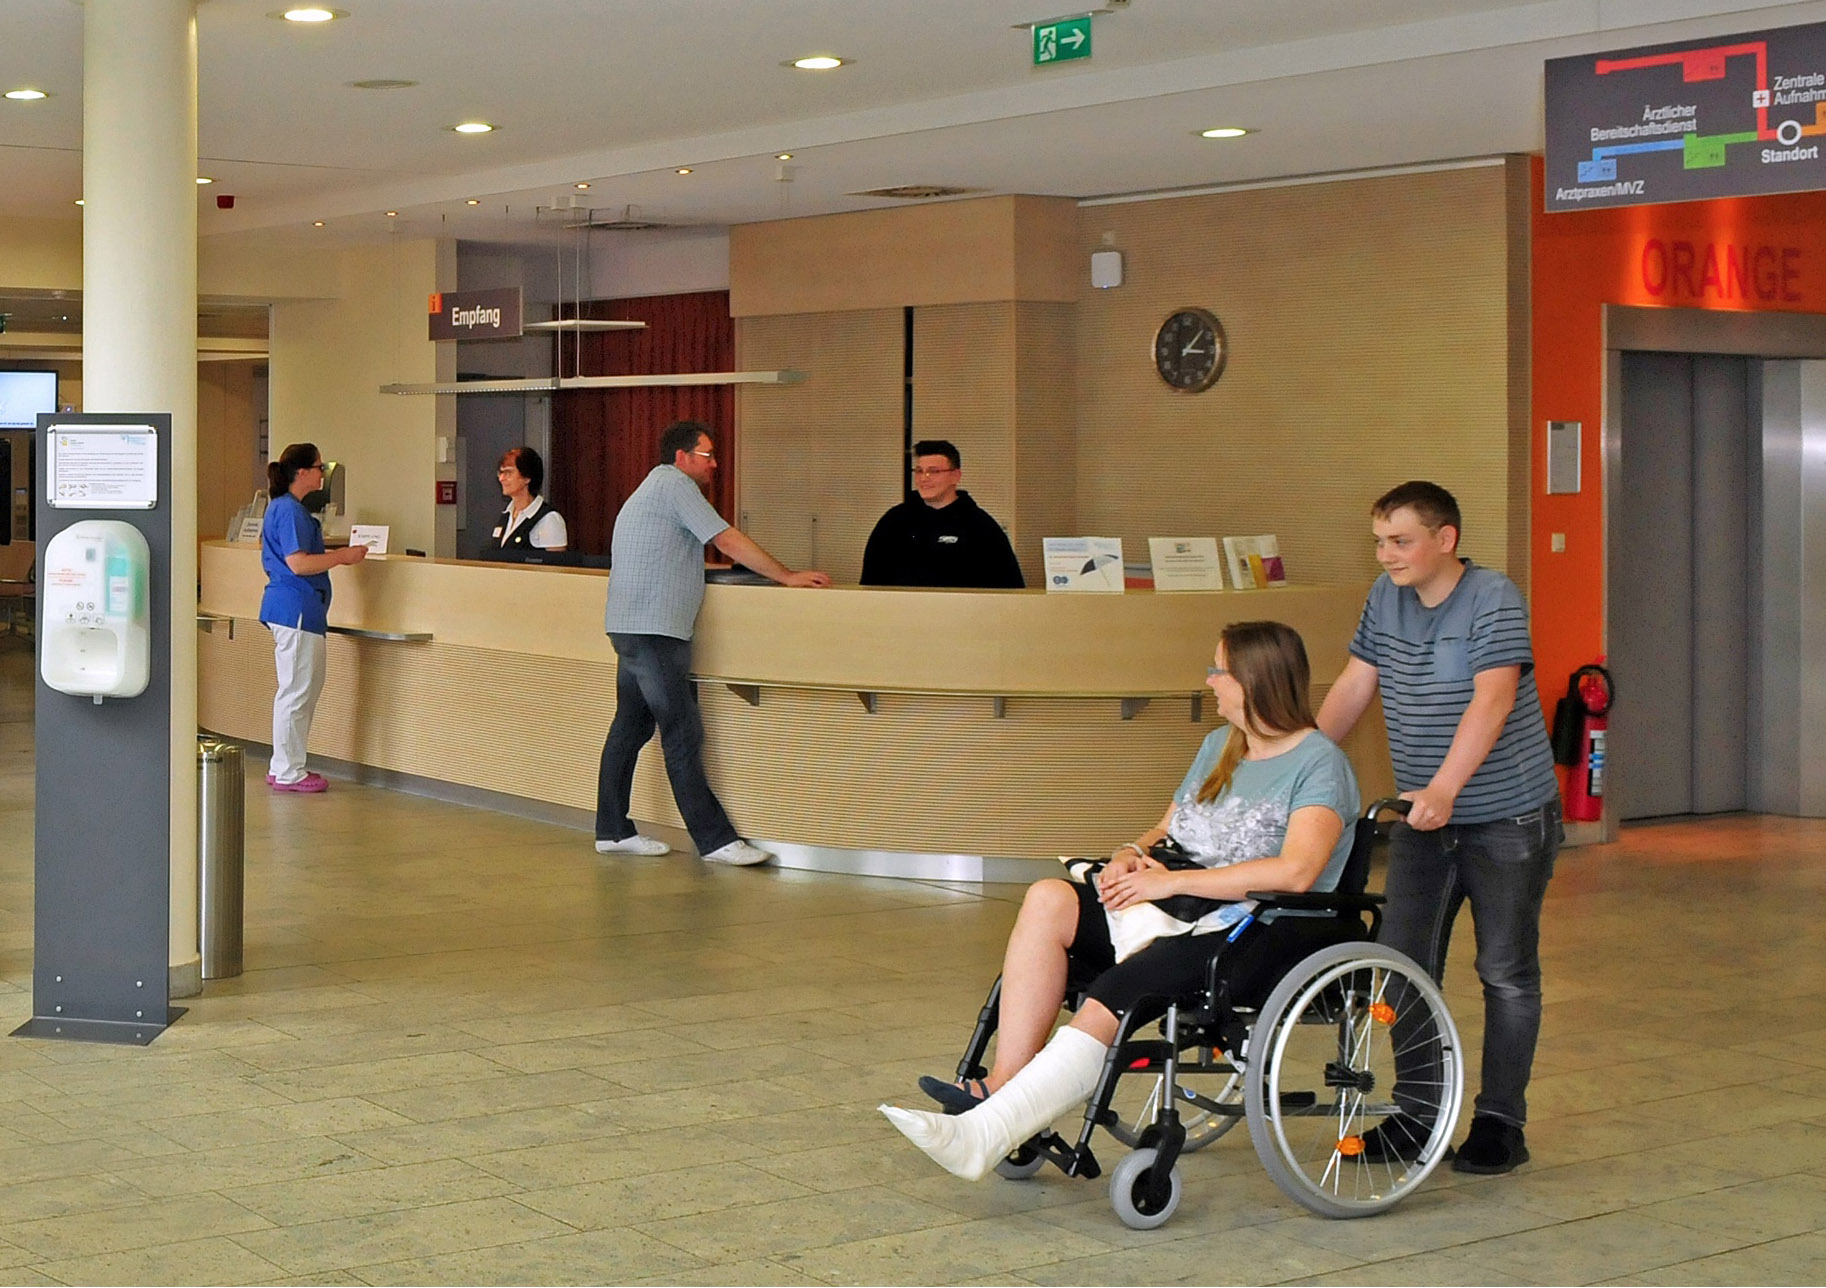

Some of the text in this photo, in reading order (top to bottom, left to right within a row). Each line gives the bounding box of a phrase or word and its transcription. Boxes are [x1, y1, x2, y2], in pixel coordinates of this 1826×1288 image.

[1773, 72, 1825, 91] Zentrale
[1642, 104, 1697, 121] Ärztlicher
[1590, 118, 1697, 142] Bereitschaftsdienst
[1761, 145, 1819, 164] Standort
[1555, 180, 1645, 202] Arztpraxen/MVZ
[1641, 238, 1803, 302] ORANGE
[451, 304, 501, 330] Empfang
